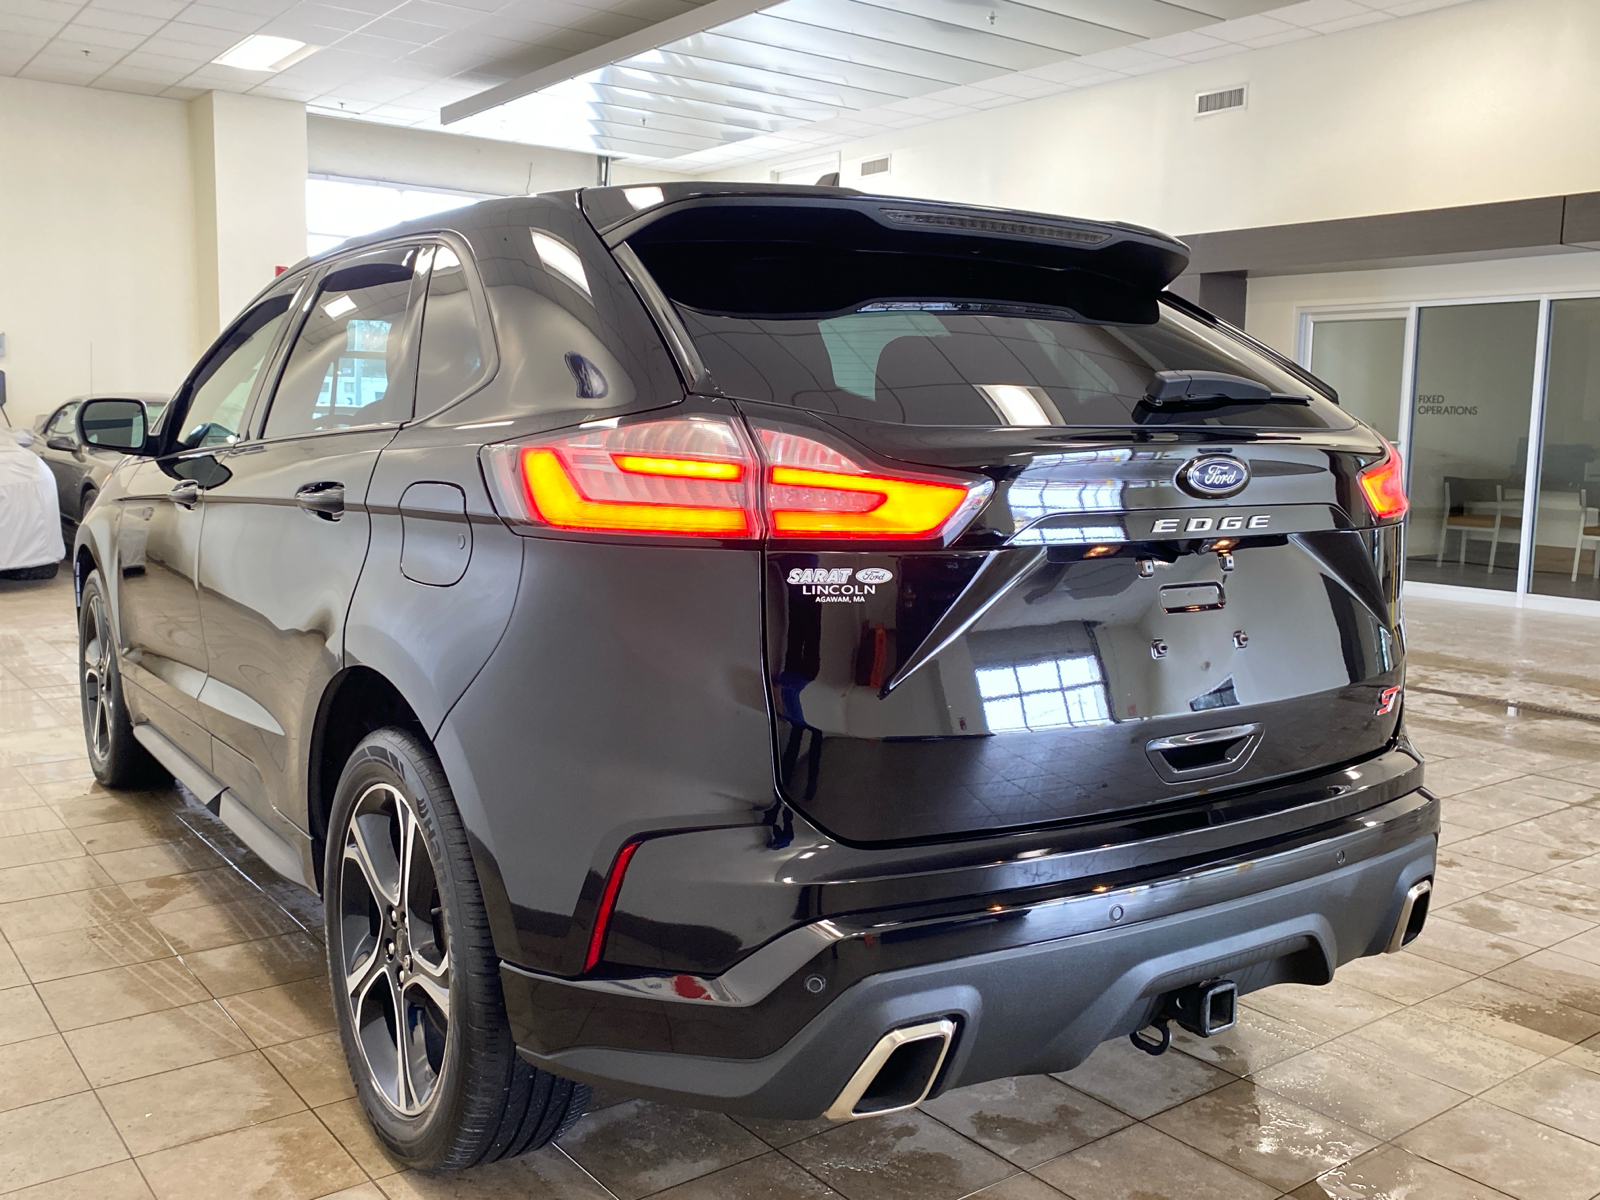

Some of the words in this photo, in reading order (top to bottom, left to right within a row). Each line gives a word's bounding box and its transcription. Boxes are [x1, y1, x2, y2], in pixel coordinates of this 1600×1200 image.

[1418, 394, 1445, 404] FIXED
[1417, 405, 1478, 415] OPERATIONS
[1203, 463, 1237, 486] Ford
[1150, 514, 1271, 533] EDGE
[786, 567, 853, 584] SARAT
[861, 569, 887, 582] Ford
[802, 585, 876, 595] LINCOLN
[1376, 685, 1400, 716] ST
